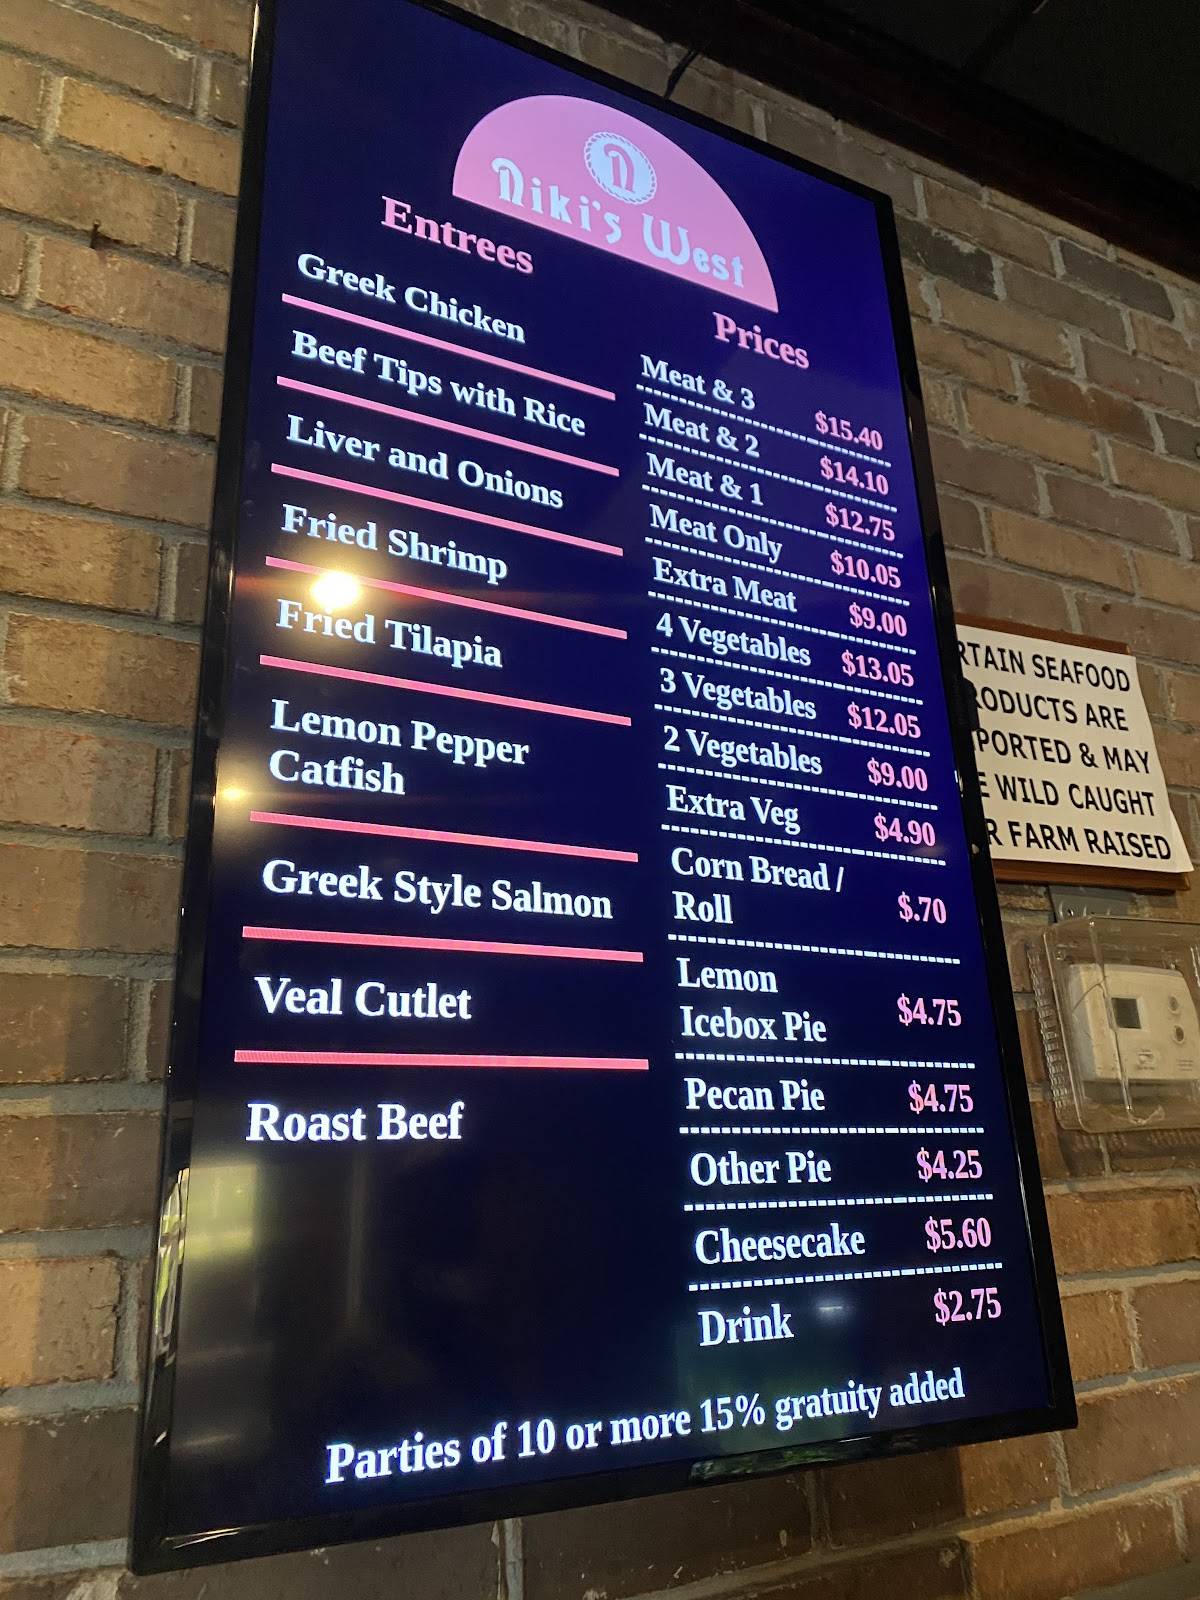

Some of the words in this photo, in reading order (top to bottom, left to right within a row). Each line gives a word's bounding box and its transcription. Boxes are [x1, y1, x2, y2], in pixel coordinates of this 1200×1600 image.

[381, 196, 534, 274] Entrees
[491, 157, 622, 244] Niki's
[642, 213, 744, 289] West
[298, 253, 396, 303] Greek
[405, 286, 526, 344] Chicken
[713, 311, 810, 369] Prices
[292, 330, 366, 374] Beef
[374, 353, 442, 396] Tips
[450, 379, 516, 417] with
[523, 397, 585, 436] Rice
[640, 354, 707, 395] Meat
[712, 379, 735, 404] &
[740, 387, 756, 410] 3
[643, 403, 710, 443] Meat
[716, 426, 739, 452] &
[745, 434, 760, 458] 2
[815, 410, 883, 451] $15.40
[287, 414, 380, 462] Liver
[388, 447, 448, 480] and
[458, 460, 563, 509] Onions
[646, 452, 714, 492] Meat
[720, 475, 743, 501] &
[751, 483, 764, 506] 1
[820, 456, 889, 496] $14.10
[649, 504, 717, 544] Meat
[723, 524, 783, 564] Only
[825, 502, 895, 542] $12.75
[281, 504, 378, 551] Fried
[388, 529, 508, 585] Shrimp
[652, 556, 728, 597] Extra
[732, 575, 797, 612] Meat
[830, 550, 901, 589] $10.05
[276, 598, 375, 644] Fried
[385, 618, 503, 669] Tilapia
[656, 613, 673, 638] 4
[678, 615, 811, 667] Vegetables
[849, 602, 907, 637] $9.00
[841, 650, 914, 688] $13.05
[1032, 654, 1130, 692] SEAFOOD
[660, 668, 676, 694] 3
[682, 671, 817, 720] Vegetables
[271, 699, 401, 748] Lemon
[411, 720, 530, 767] Pepper
[847, 702, 921, 739] $12.05
[1086, 703, 1129, 731] ARE
[663, 725, 680, 752] 2
[686, 728, 823, 775] Vegetables
[976, 728, 1071, 764] PORTED
[1078, 742, 1098, 769] &
[1103, 746, 1150, 774] MAY
[269, 749, 405, 796] Catfish
[867, 757, 928, 792] $9.00
[665, 784, 746, 821] Extra
[750, 796, 801, 835] Veg
[994, 773, 1059, 806] WILD
[1068, 783, 1155, 816] CAUGHT
[874, 813, 936, 847] $4.90
[1007, 820, 1079, 852] FARM
[1084, 828, 1172, 860] RAISED
[262, 859, 383, 902] Greek
[394, 870, 481, 914] Style
[491, 879, 613, 919] Salmon
[671, 847, 744, 881] Corn
[749, 856, 831, 892] Bread
[672, 890, 734, 924] Roll
[898, 892, 947, 924] $.70
[676, 957, 778, 993] Lemon
[255, 976, 342, 1015] Veal
[355, 982, 472, 1020] Cutlet
[897, 993, 962, 1027] $4.75
[680, 1005, 778, 1041] Icebox
[782, 1011, 827, 1042] Pie
[684, 1077, 775, 1111] Pecan
[779, 1079, 825, 1111] Pie
[908, 1080, 974, 1114] $4.75
[245, 1103, 366, 1141] Roast
[376, 1101, 465, 1141] Beef
[690, 1150, 781, 1186] Other
[785, 1150, 831, 1183] Pie
[916, 1147, 983, 1183] $4.25
[695, 1223, 866, 1265] Cheesecake
[925, 1216, 991, 1253] $5.60
[698, 1304, 795, 1346] Drink
[934, 1287, 1002, 1326] $2.75
[324, 1431, 461, 1484] Parties
[471, 1421, 507, 1464] of
[517, 1418, 556, 1457] 10
[566, 1419, 602, 1451] or
[610, 1408, 692, 1446] more
[700, 1393, 765, 1433] 15%
[775, 1379, 882, 1430] gratuity
[890, 1367, 965, 1406] added
